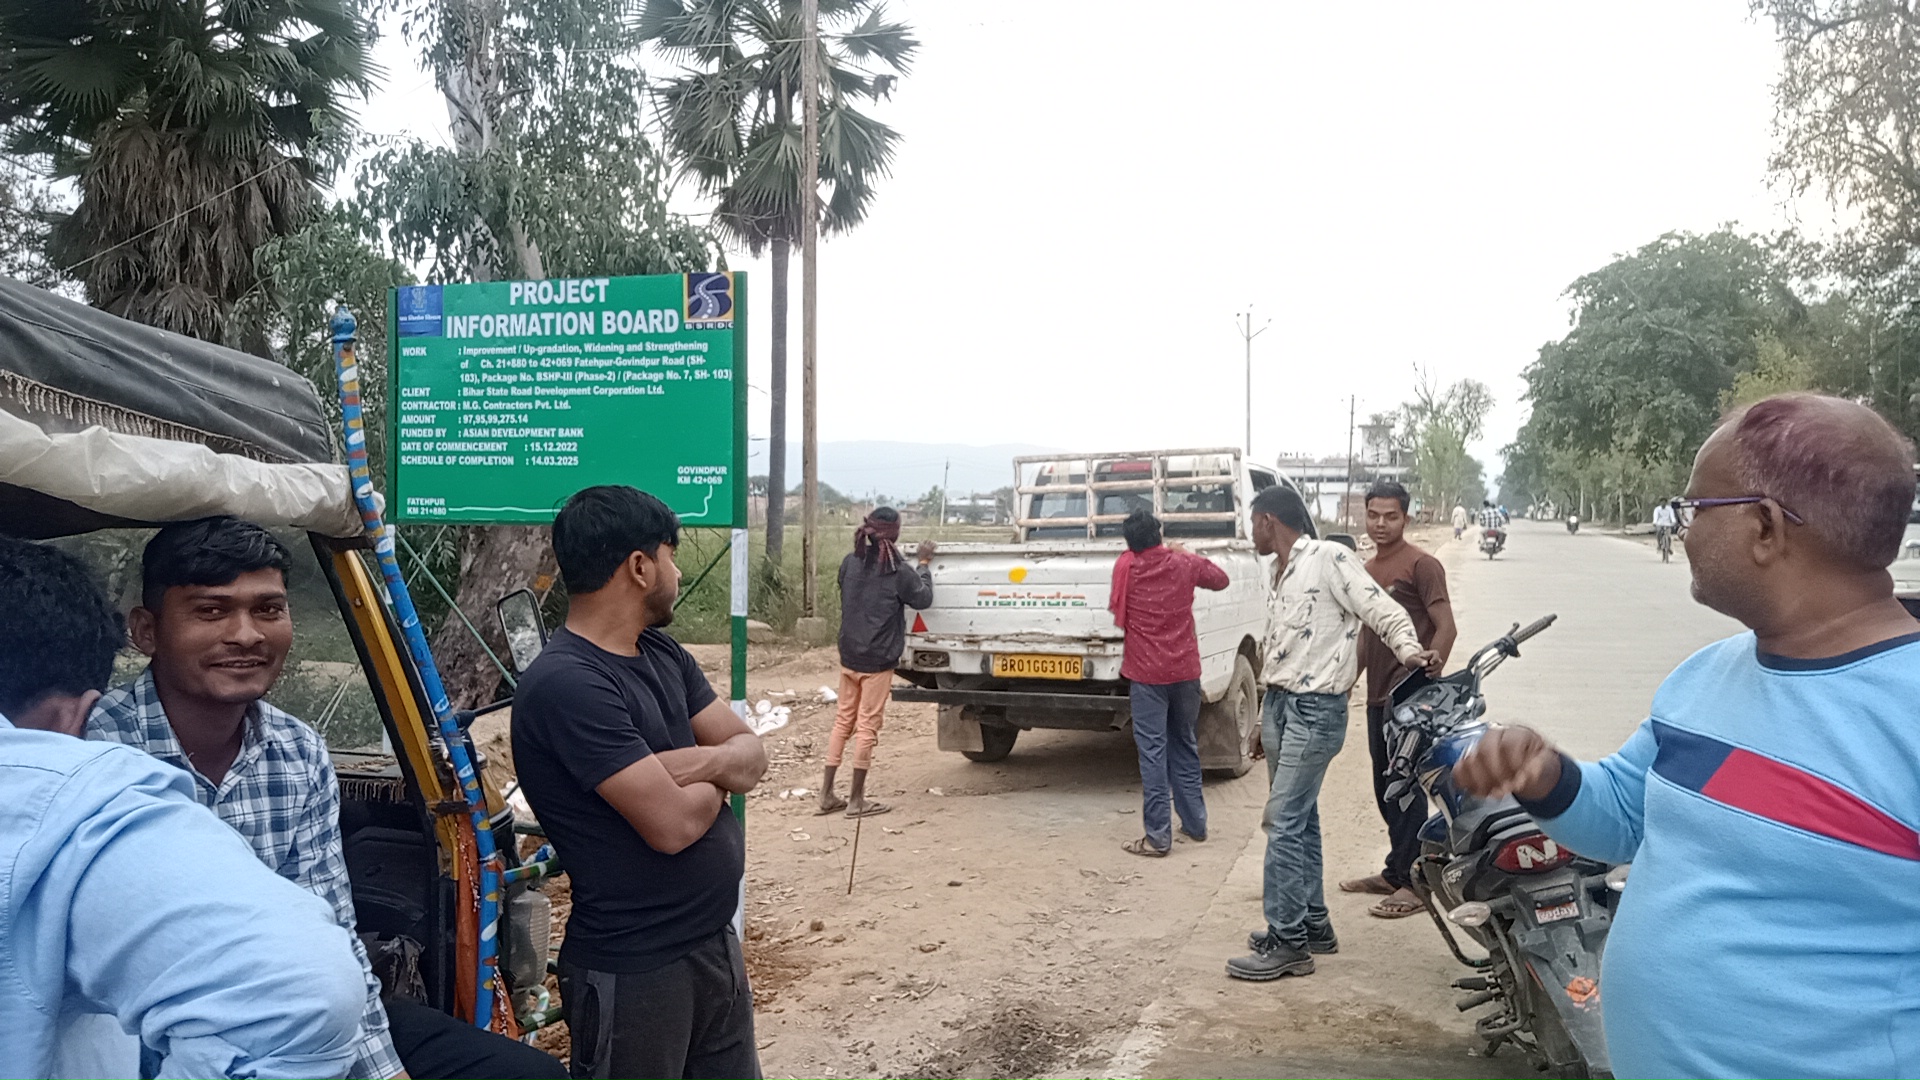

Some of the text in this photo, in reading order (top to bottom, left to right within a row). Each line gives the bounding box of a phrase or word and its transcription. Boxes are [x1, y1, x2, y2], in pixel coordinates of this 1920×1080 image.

[510, 280, 609, 305] PROJECT
[447, 309, 679, 338] INFORMATION BOARD
[403, 347, 426, 356] WORK
[463, 345, 516, 357] Improvement
[584, 343, 624, 354] Widening
[626, 342, 643, 352] and
[645, 341, 708, 353] Strengthening
[460, 360, 469, 369] of
[481, 359, 494, 368] Ch.
[528, 359, 538, 367] to
[662, 356, 685, 365] Road
[482, 373, 518, 385] Package
[520, 372, 534, 381] No.
[575, 371, 616, 383] (Phase-2)
[623, 369, 664, 382] (Package
[666, 370, 681, 380] No.
[402, 387, 430, 397] CLIENT
[463, 387, 484, 396] Bihar
[487, 387, 508, 396] State
[511, 386, 532, 395] Road
[534, 386, 591, 397] Development
[593, 386, 645, 396] Corporation
[647, 385, 664, 394] Ltd.
[401, 401, 456, 410] CONTRACTOR
[463, 401, 481, 410] M.G.
[483, 401, 533, 410] Contractors
[535, 400, 552, 409] Pvt.
[554, 400, 571, 409] Ltd.
[401, 415, 436, 424] AMOUNT
[401, 428, 433, 437] FUNDED
[435, 428, 446, 437] BY
[463, 428, 489, 437] ASIAN
[491, 428, 556, 437] DEVELOPMENT
[558, 428, 583, 437] BANK
[401, 442, 421, 451] DATE
[423, 442, 434, 451] OF
[436, 442, 508, 451] COMMENCEMENT
[530, 442, 577, 451] 15.12.2022
[402, 455, 445, 465] SCHEDULE
[445, 456, 456, 465] OF
[459, 456, 514, 465] COMPLETION
[532, 456, 578, 465] 14.03.2025
[678, 466, 727, 475] GOVINDPUR
[678, 476, 690, 484] KM
[407, 498, 445, 506] FATEHPUR
[1001, 658, 1080, 674] BR01GG3106
